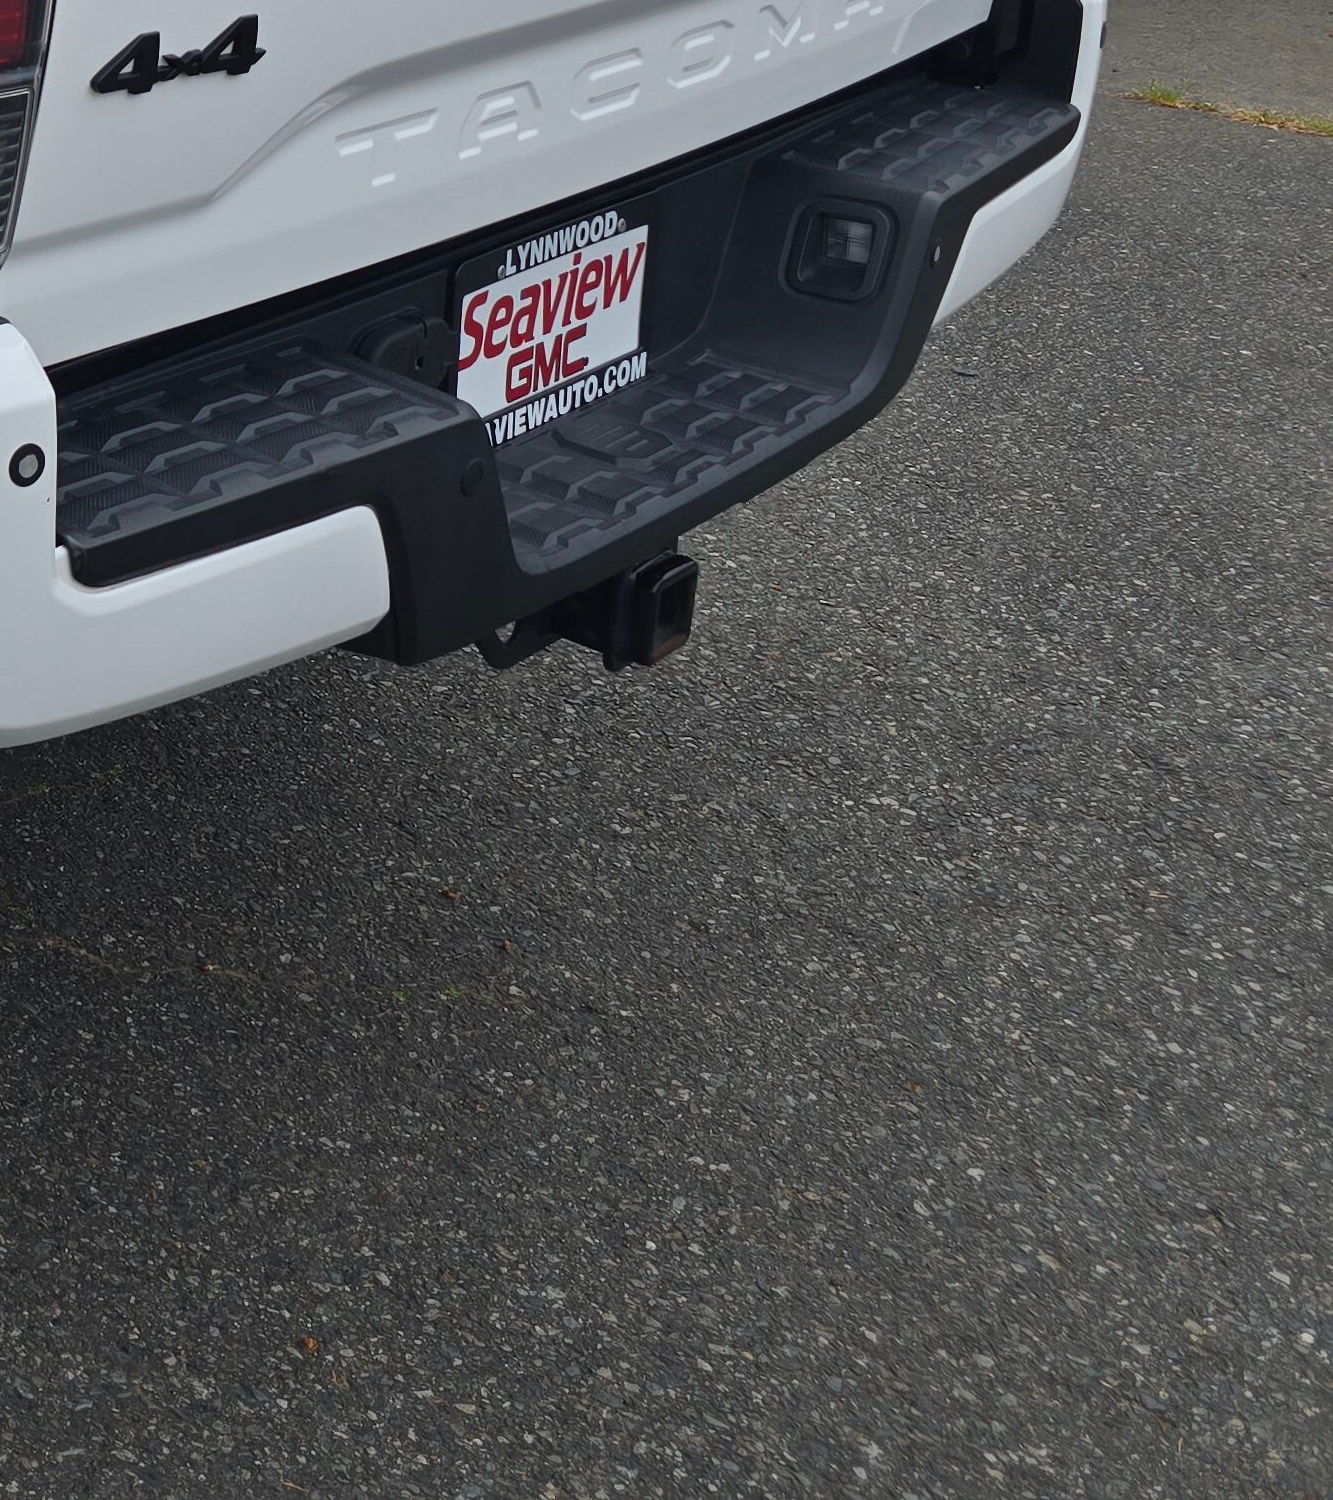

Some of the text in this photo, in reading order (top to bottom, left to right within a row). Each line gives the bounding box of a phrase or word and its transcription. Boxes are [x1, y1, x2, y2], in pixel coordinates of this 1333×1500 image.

[505, 210, 619, 277] LYNNWOOD
[458, 241, 647, 373] Seaview
[504, 323, 590, 404] GMC
